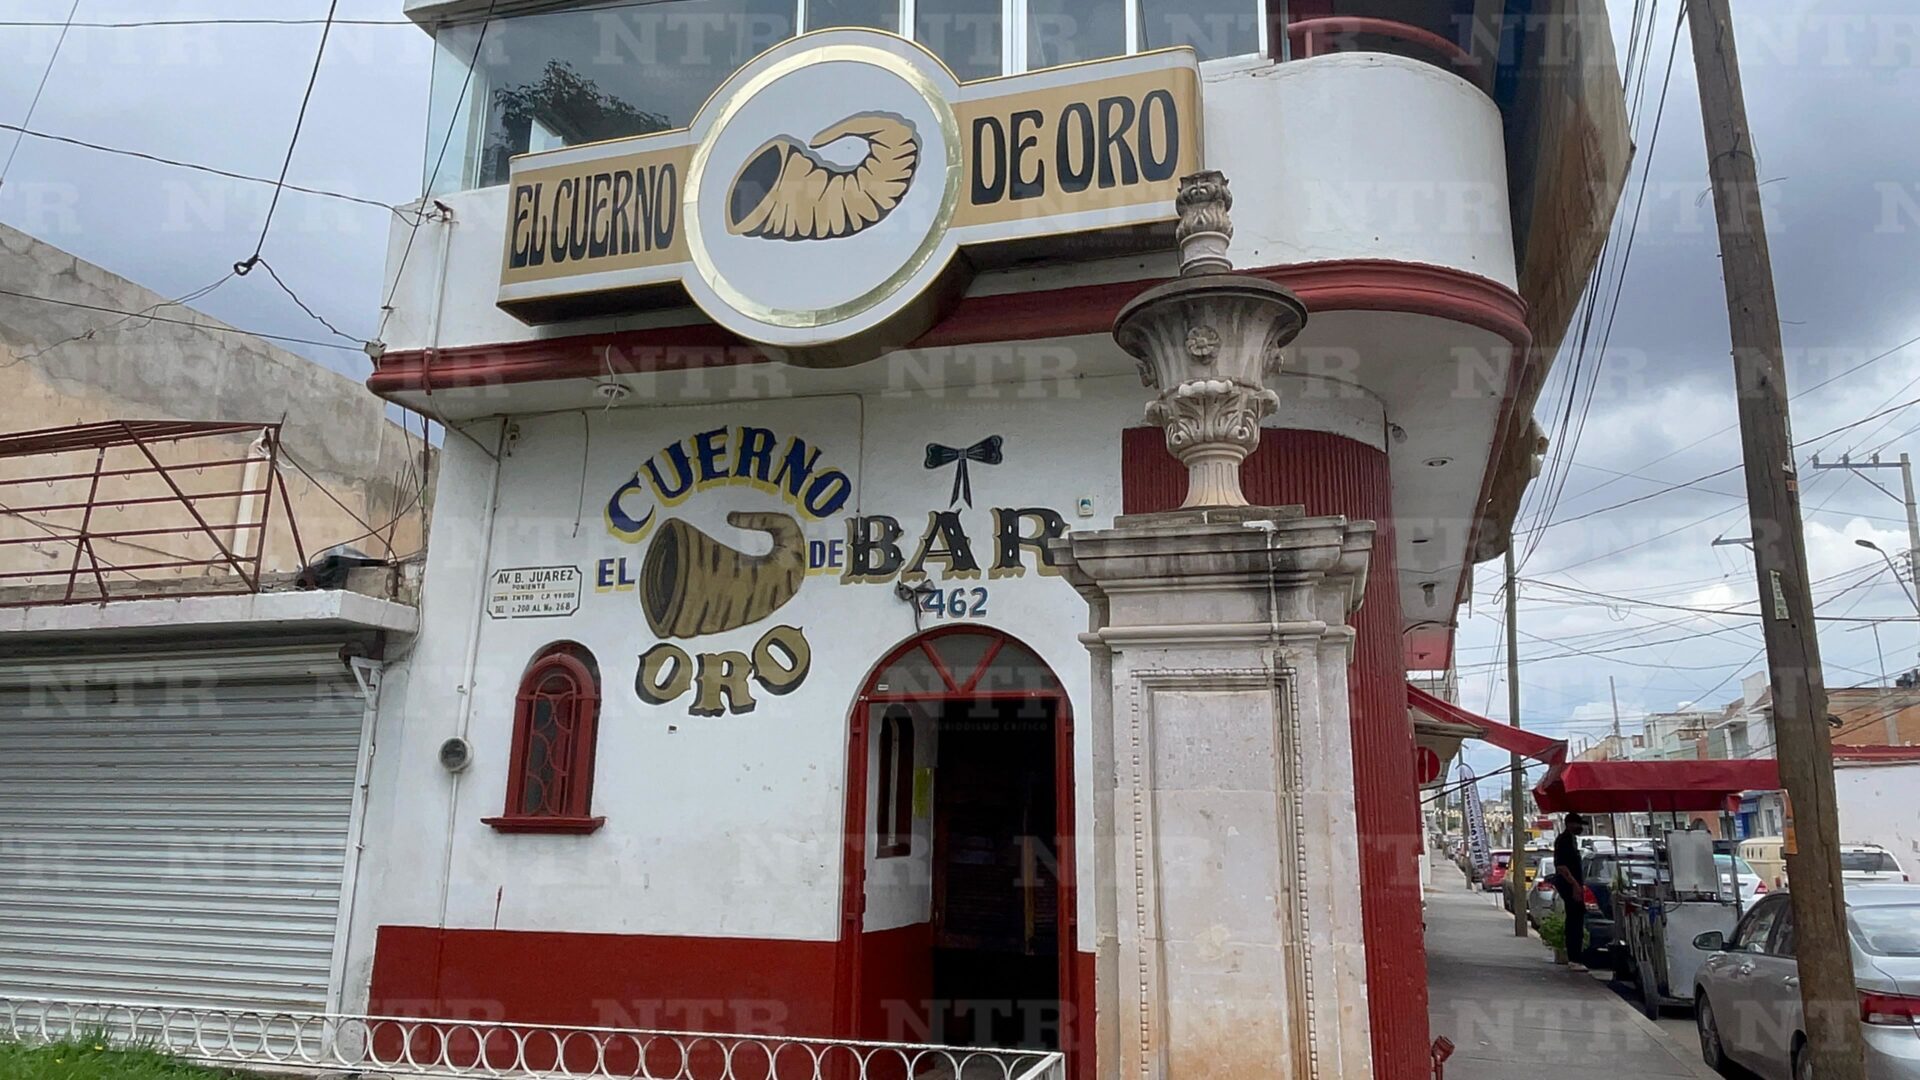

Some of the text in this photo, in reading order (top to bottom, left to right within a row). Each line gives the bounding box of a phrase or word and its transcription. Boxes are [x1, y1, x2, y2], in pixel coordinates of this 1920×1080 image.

[509, 183, 547, 269] EL
[550, 162, 677, 263] CUERNO
[971, 109, 1046, 206] DE
[1055, 88, 1179, 194] ORO
[603, 425, 851, 544] CUERNO
[595, 556, 635, 593] EL
[804, 538, 845, 576] DE
[840, 506, 1072, 585] BAR
[497, 569, 574, 584] AV. B. JUAREZ
[922, 586, 989, 619] 462
[634, 624, 812, 717] ORO
